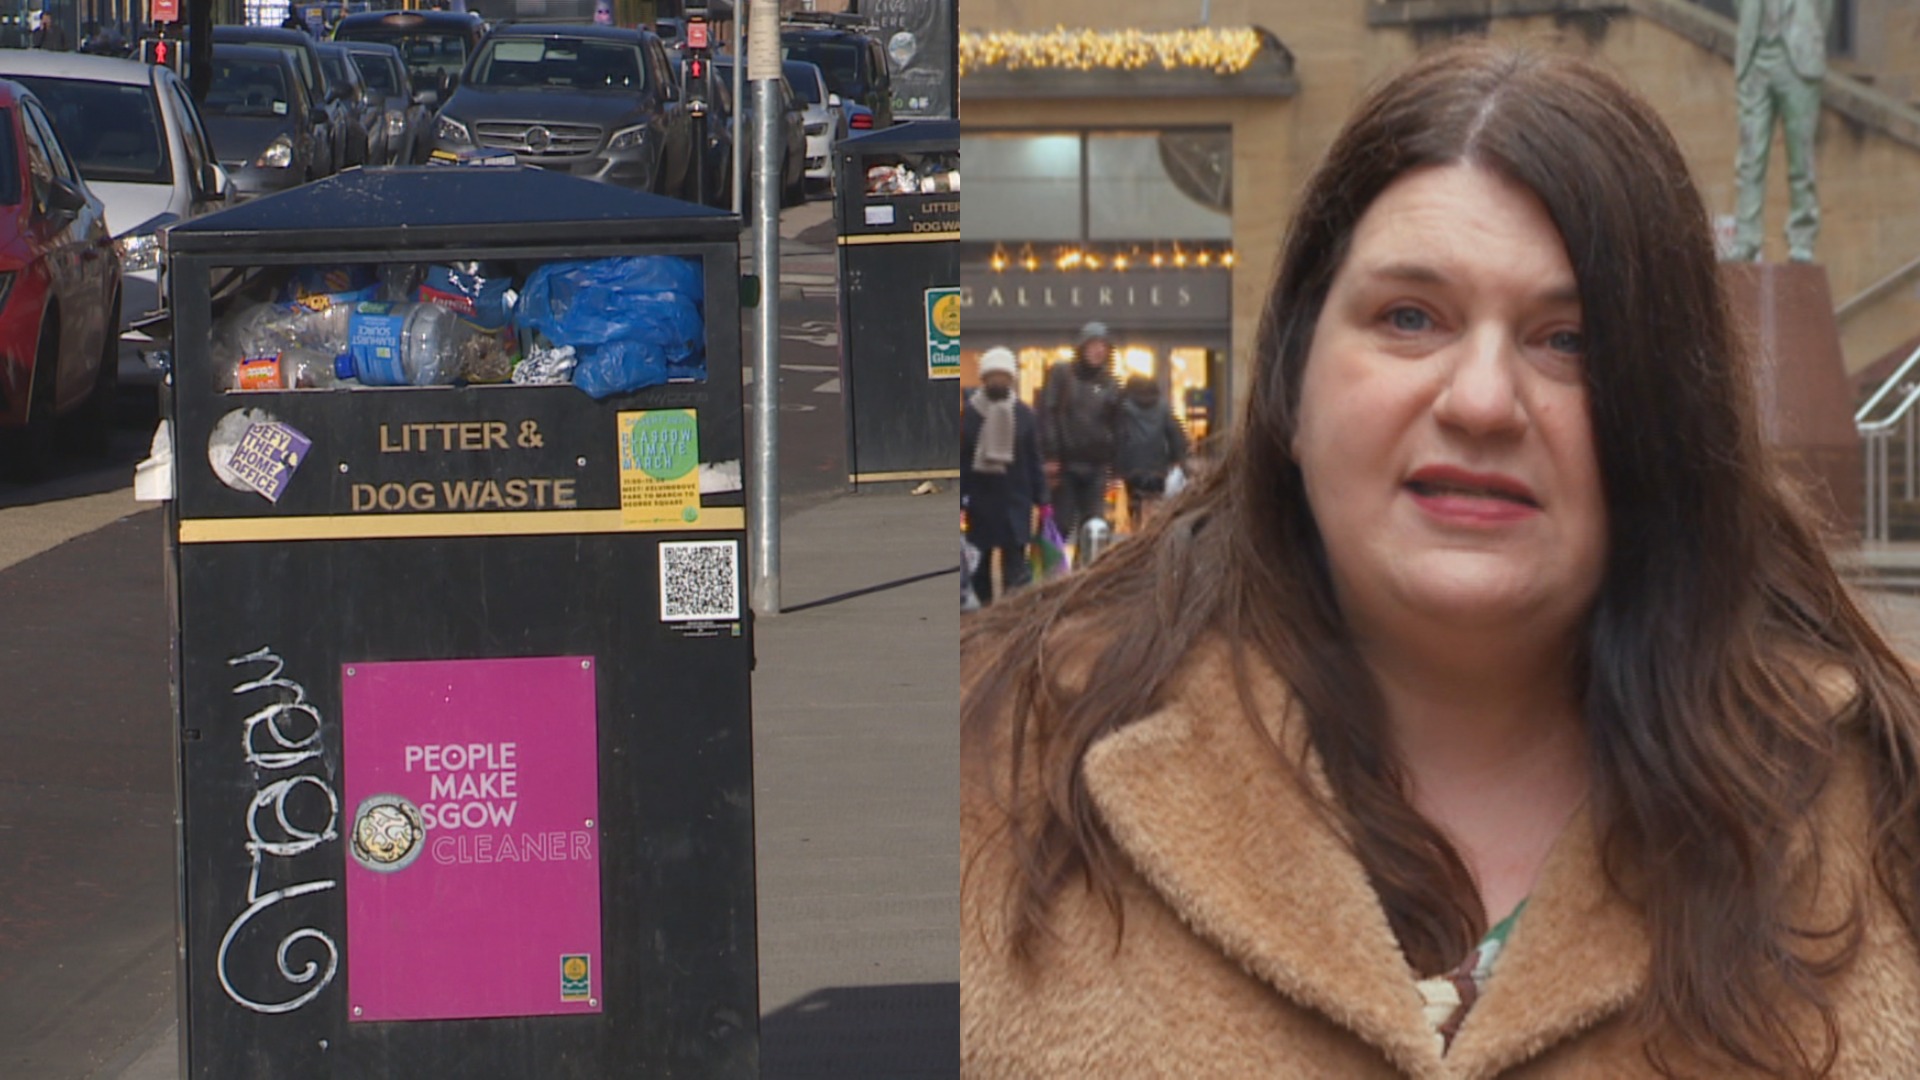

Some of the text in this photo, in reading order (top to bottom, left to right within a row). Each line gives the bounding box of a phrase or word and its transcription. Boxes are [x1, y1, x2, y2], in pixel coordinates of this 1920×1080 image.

[913, 221, 941, 232] DOG
[960, 286, 1192, 307] GALLERIES
[248, 433, 274, 457] THE
[379, 420, 544, 453] LITTER &
[622, 428, 692, 444] GLASGOW
[622, 441, 687, 457] CLIMATE
[232, 459, 276, 493] OFFICE
[238, 446, 279, 477] HOME
[622, 457, 673, 470] MARCH
[351, 478, 577, 512] DOG WASTE
[405, 742, 517, 773] PEOPLE
[430, 772, 517, 801] MAKE
[421, 801, 517, 830] SGOW
[431, 831, 592, 865] CLEANER
